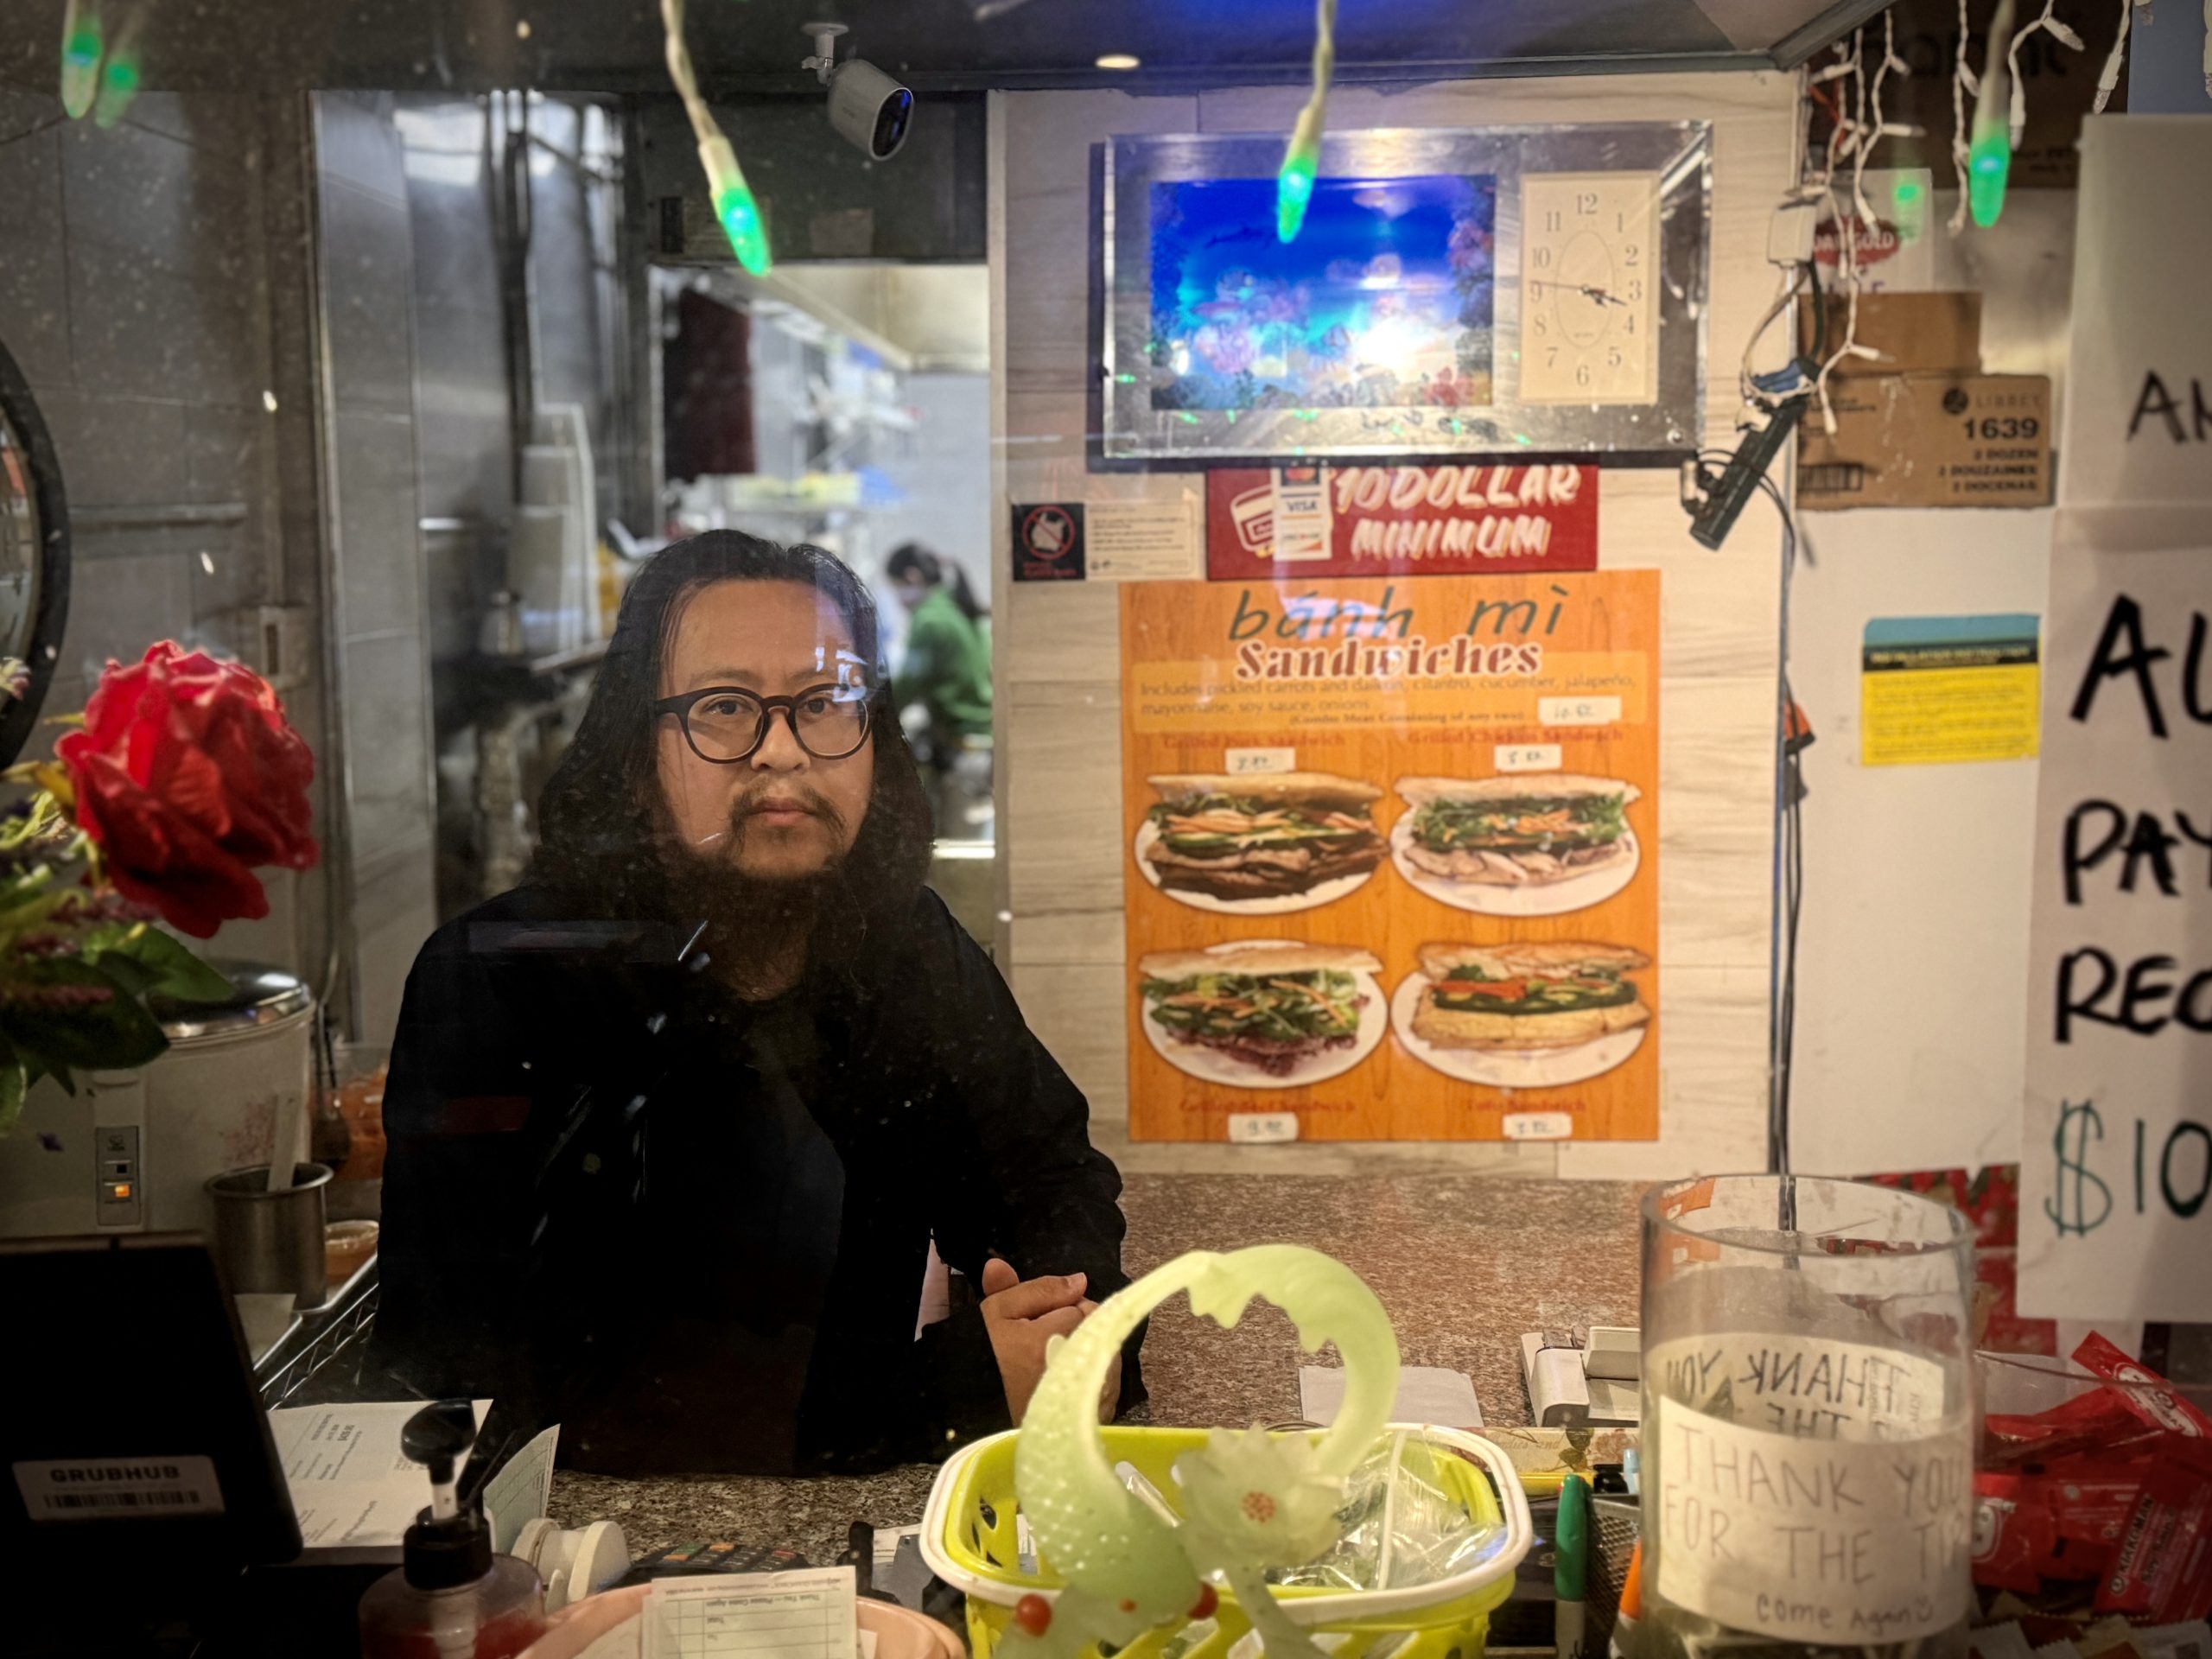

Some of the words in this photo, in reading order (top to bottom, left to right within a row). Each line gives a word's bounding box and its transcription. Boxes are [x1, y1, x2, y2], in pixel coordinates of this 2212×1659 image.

[1576, 194, 1598, 215] 12
[1546, 212, 1560, 232] 11
[1617, 213, 1623, 233] 1
[1533, 247, 1551, 269] 10
[1625, 245, 1638, 266] 2
[1530, 281, 1542, 302] 9
[1629, 280, 1642, 302] 3
[1534, 315, 1547, 336] 8
[1624, 314, 1635, 335] 4
[1546, 347, 1558, 368] 7
[1608, 347, 1621, 366] 5
[1576, 365, 1590, 386] 6
[1964, 417, 2040, 440] 1639
[1287, 499, 1319, 512] VISA
[1351, 515, 1552, 561] MINIMUM
[1228, 586, 1414, 641] bánh
[1467, 583, 1569, 636] mì
[1236, 638, 1541, 679] Sandwiches
[2044, 1098, 2212, 1238] $10
[49, 1465, 180, 1484] GRUBHUB
[1678, 1424, 1864, 1512] THANK
[1893, 1456, 1966, 1518] YOU
[1666, 1483, 1733, 1560] FOR
[1775, 1524, 1876, 1586] THE
[2117, 1497, 2154, 1573] KIKKOMAN
